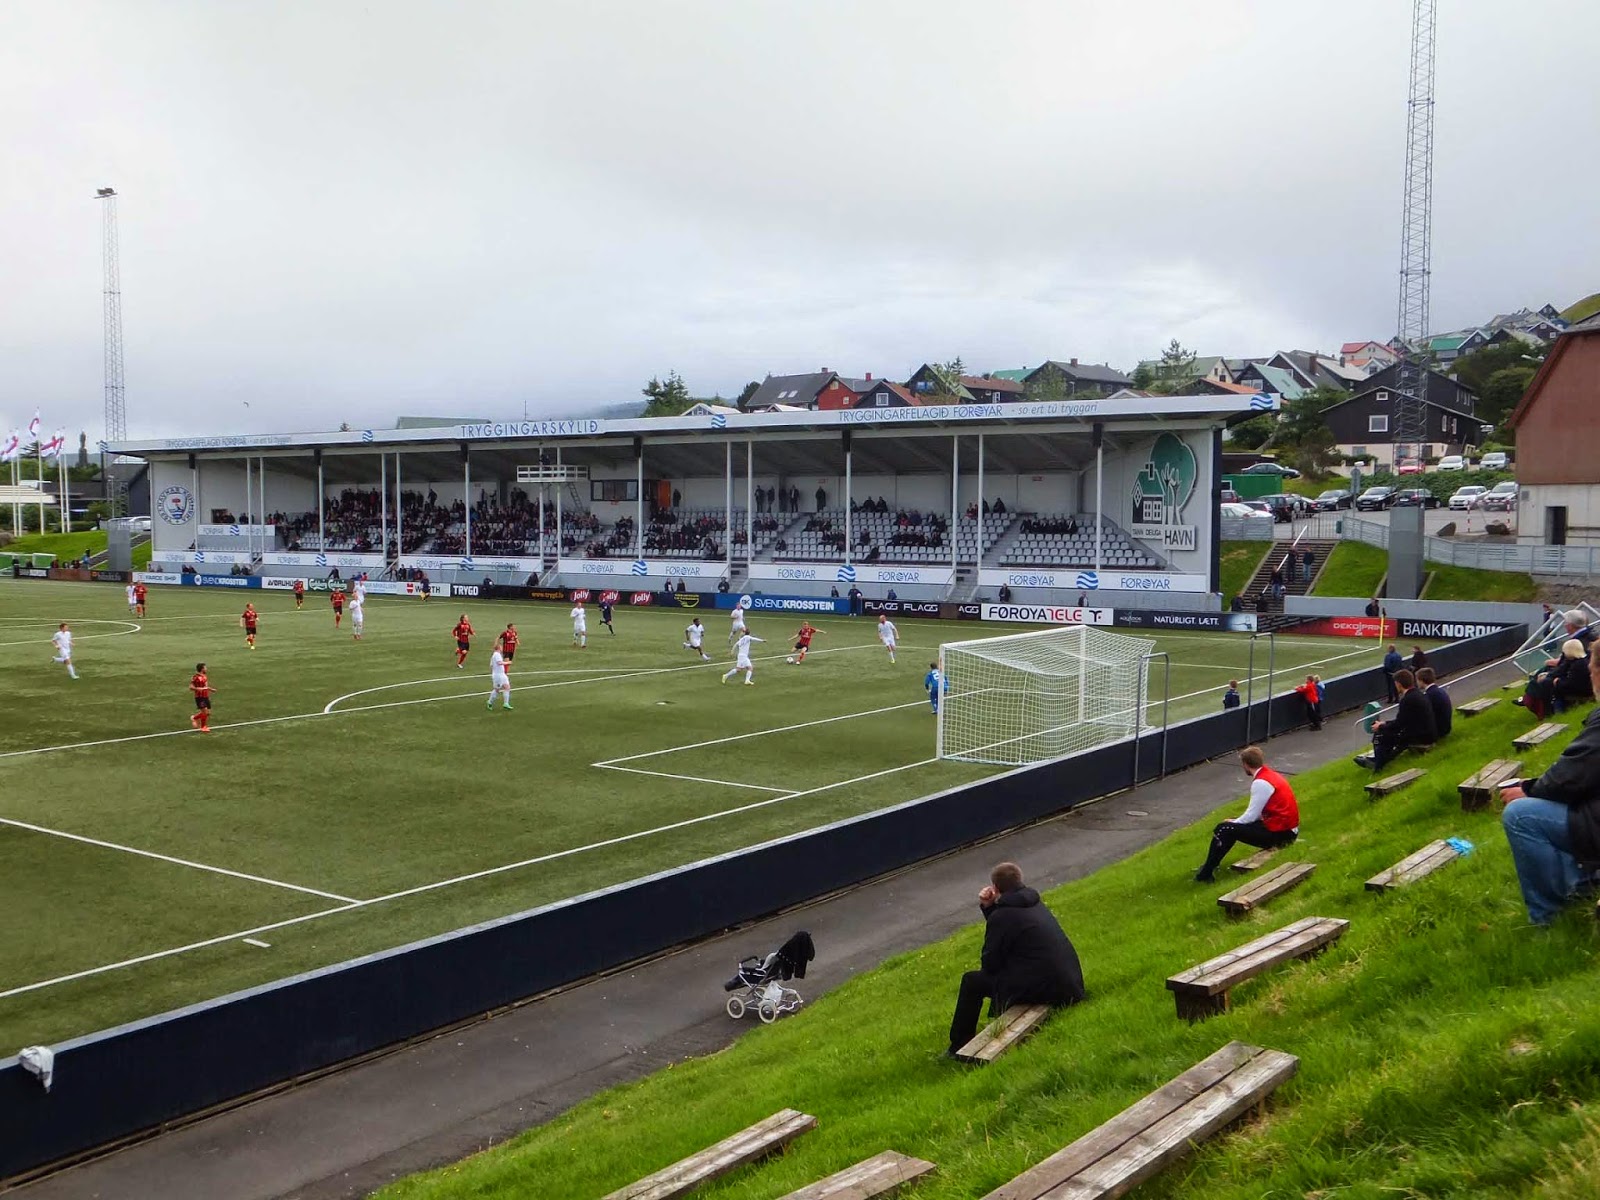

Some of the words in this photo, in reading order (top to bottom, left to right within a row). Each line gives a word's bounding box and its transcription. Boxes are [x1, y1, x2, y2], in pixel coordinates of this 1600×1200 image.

[838, 406, 949, 422] TRYGGINGARFELAGIÐ
[953, 404, 1003, 418] FØROYAR
[1017, 407, 1029, 415] so
[1031, 405, 1044, 415] ert
[460, 420, 599, 437] TRYGGINGARSKÝLIÐ
[1164, 529, 1193, 546] HAVN
[665, 565, 701, 576] FØROYAR
[777, 569, 816, 579] FØROYAR
[877, 570, 920, 582] FØROYAR
[1008, 574, 1055, 586] FØROYAR
[1120, 576, 1170, 589] FØROYAR
[414, 585, 441, 594] WTH
[754, 598, 835, 611] SVENDKROSSTEIN
[864, 601, 899, 611] FLAGS
[903, 602, 938, 612] FLAGS
